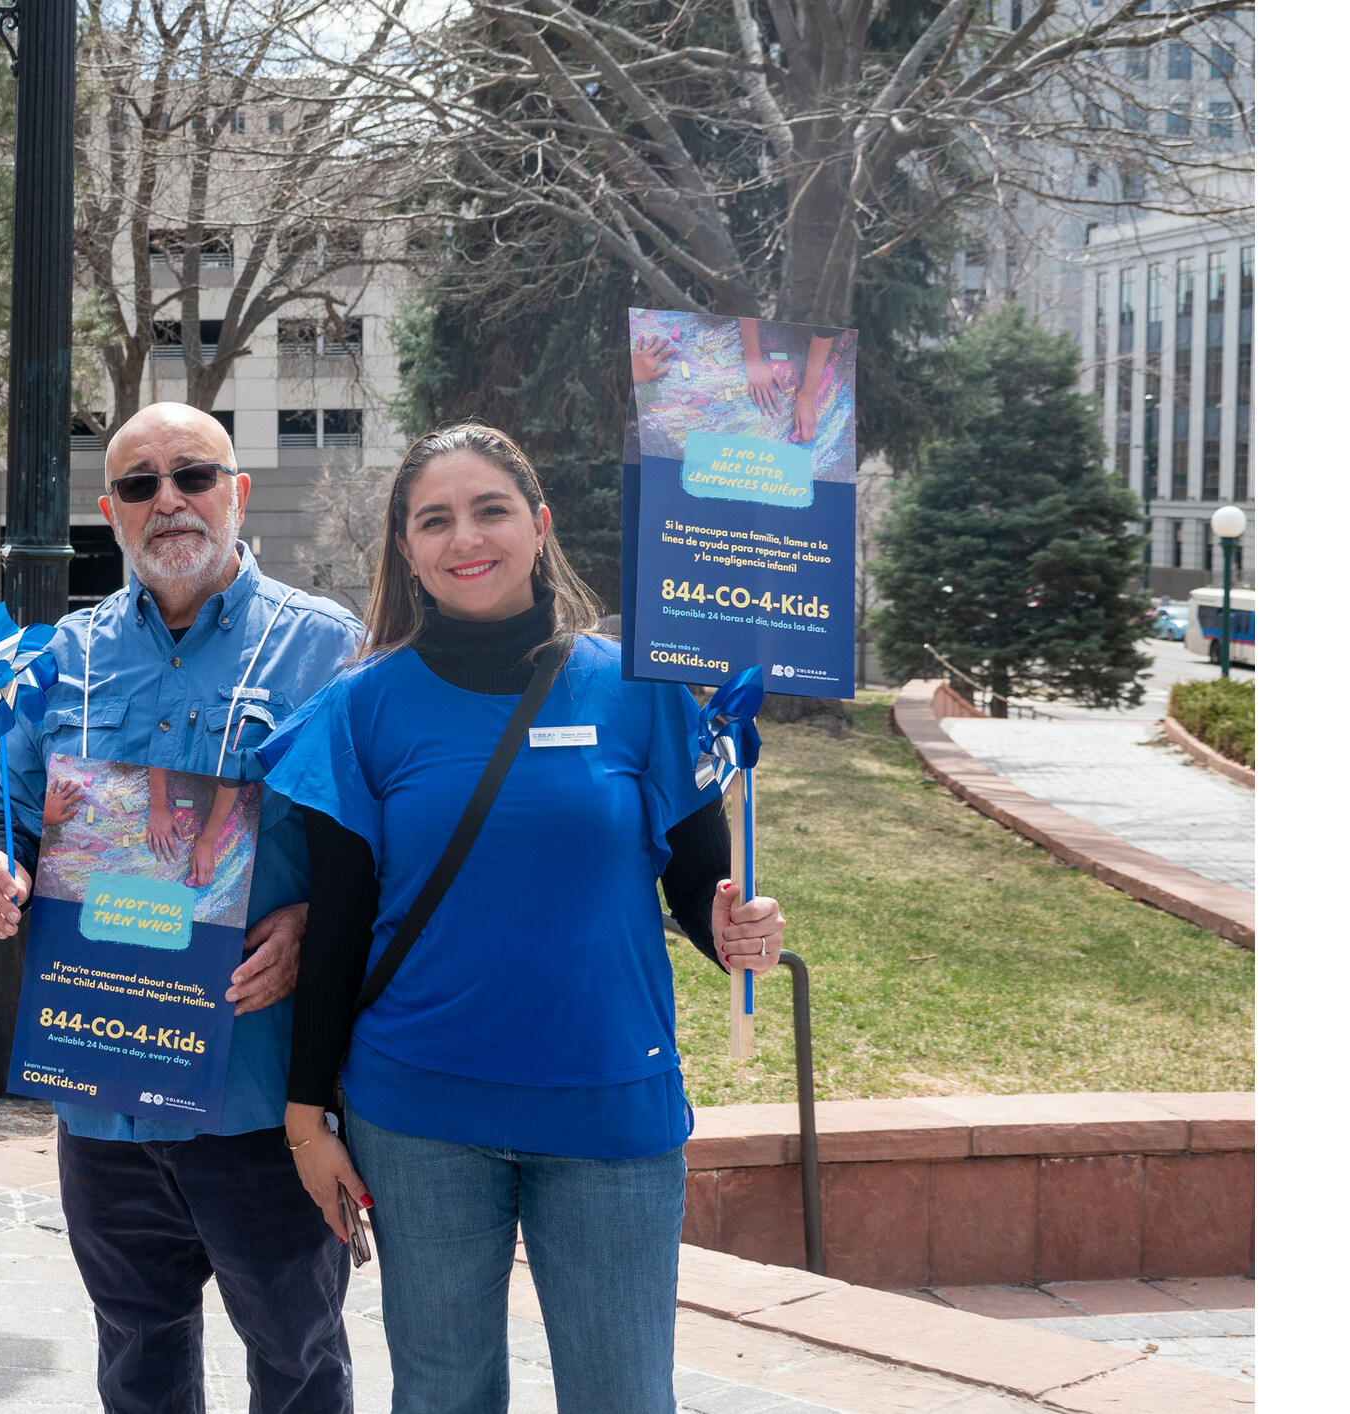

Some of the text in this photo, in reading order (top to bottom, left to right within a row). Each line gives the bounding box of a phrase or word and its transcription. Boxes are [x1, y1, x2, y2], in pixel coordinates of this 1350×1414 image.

[721, 447, 774, 463] SI NO LO
[688, 471, 807, 497] ¿ENTONCES QUIÉN?
[711, 460, 783, 482] HACE USTED,
[665, 520, 673, 529] Si
[675, 521, 684, 531] le
[685, 525, 728, 538] preocupa
[730, 531, 748, 539] una
[749, 530, 782, 545] familia,
[783, 536, 808, 548] llame
[819, 540, 828, 550] la
[686, 536, 697, 546] de
[699, 540, 729, 550] ayuda
[731, 544, 753, 553] para
[755, 547, 790, 558] reportar
[792, 551, 800, 560] el
[802, 552, 831, 563] abuso
[694, 551, 797, 573] y la negligencia infantil
[662, 579, 830, 619] 844-CO-4-Kids
[663, 606, 706, 619] Disponible
[707, 611, 718, 620] 24
[720, 612, 744, 623] horas
[745, 615, 754, 624] al
[770, 620, 792, 629] todos
[793, 622, 806, 631] los
[650, 640, 677, 649] Aprende
[650, 650, 729, 673] CO4Kids.org
[95, 893, 182, 920] IF NOT YOU,
[94, 910, 182, 935] THEN WHO?
[40, 973, 215, 1009] call the Child Abuse and Neglect Hotline
[53, 961, 60, 969] If
[91, 970, 137, 983] concerned
[138, 976, 165, 987] about
[174, 981, 205, 996] family,
[40, 1007, 205, 1054] 844-CO-4-Kids
[48, 1033, 85, 1047] Available
[87, 1040, 97, 1048] 24
[98, 1042, 121, 1053] hours
[129, 1048, 147, 1059] day,
[148, 1053, 172, 1064] every
[173, 1055, 191, 1067] day.
[24, 1061, 41, 1069] Learn
[23, 1070, 97, 1096] CO4Kids.org
